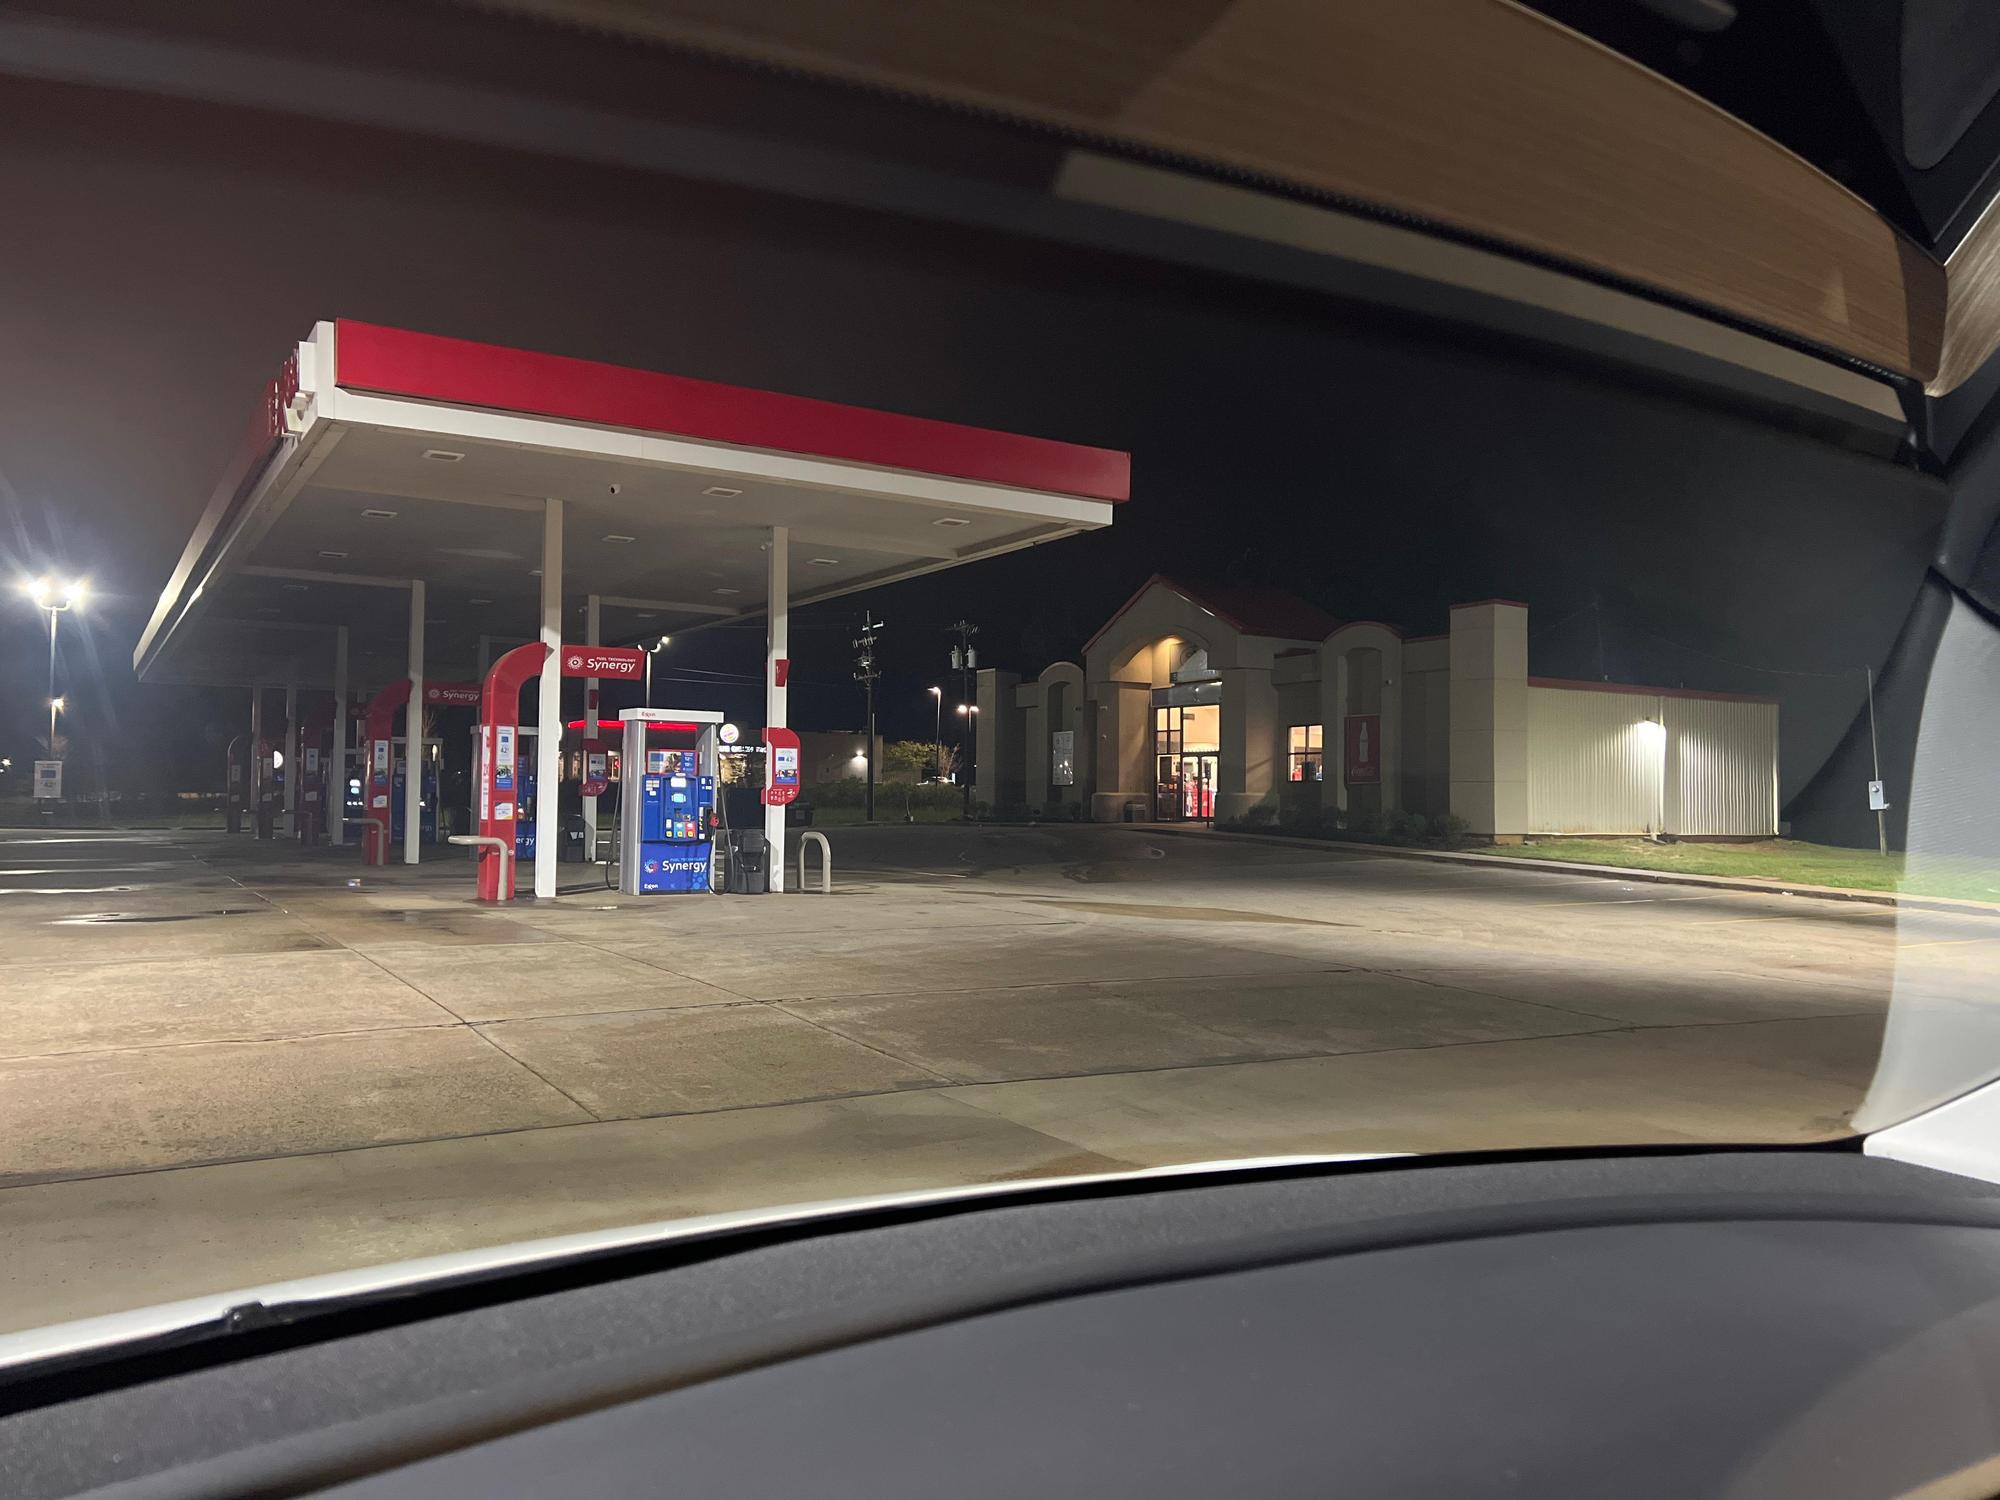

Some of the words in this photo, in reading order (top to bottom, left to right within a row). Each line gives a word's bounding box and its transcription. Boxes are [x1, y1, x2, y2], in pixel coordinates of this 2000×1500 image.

[586, 658, 635, 673] Synergy
[442, 690, 480, 702] Synergy
[515, 837, 535, 846] ergy
[662, 860, 707, 874] Synergy
